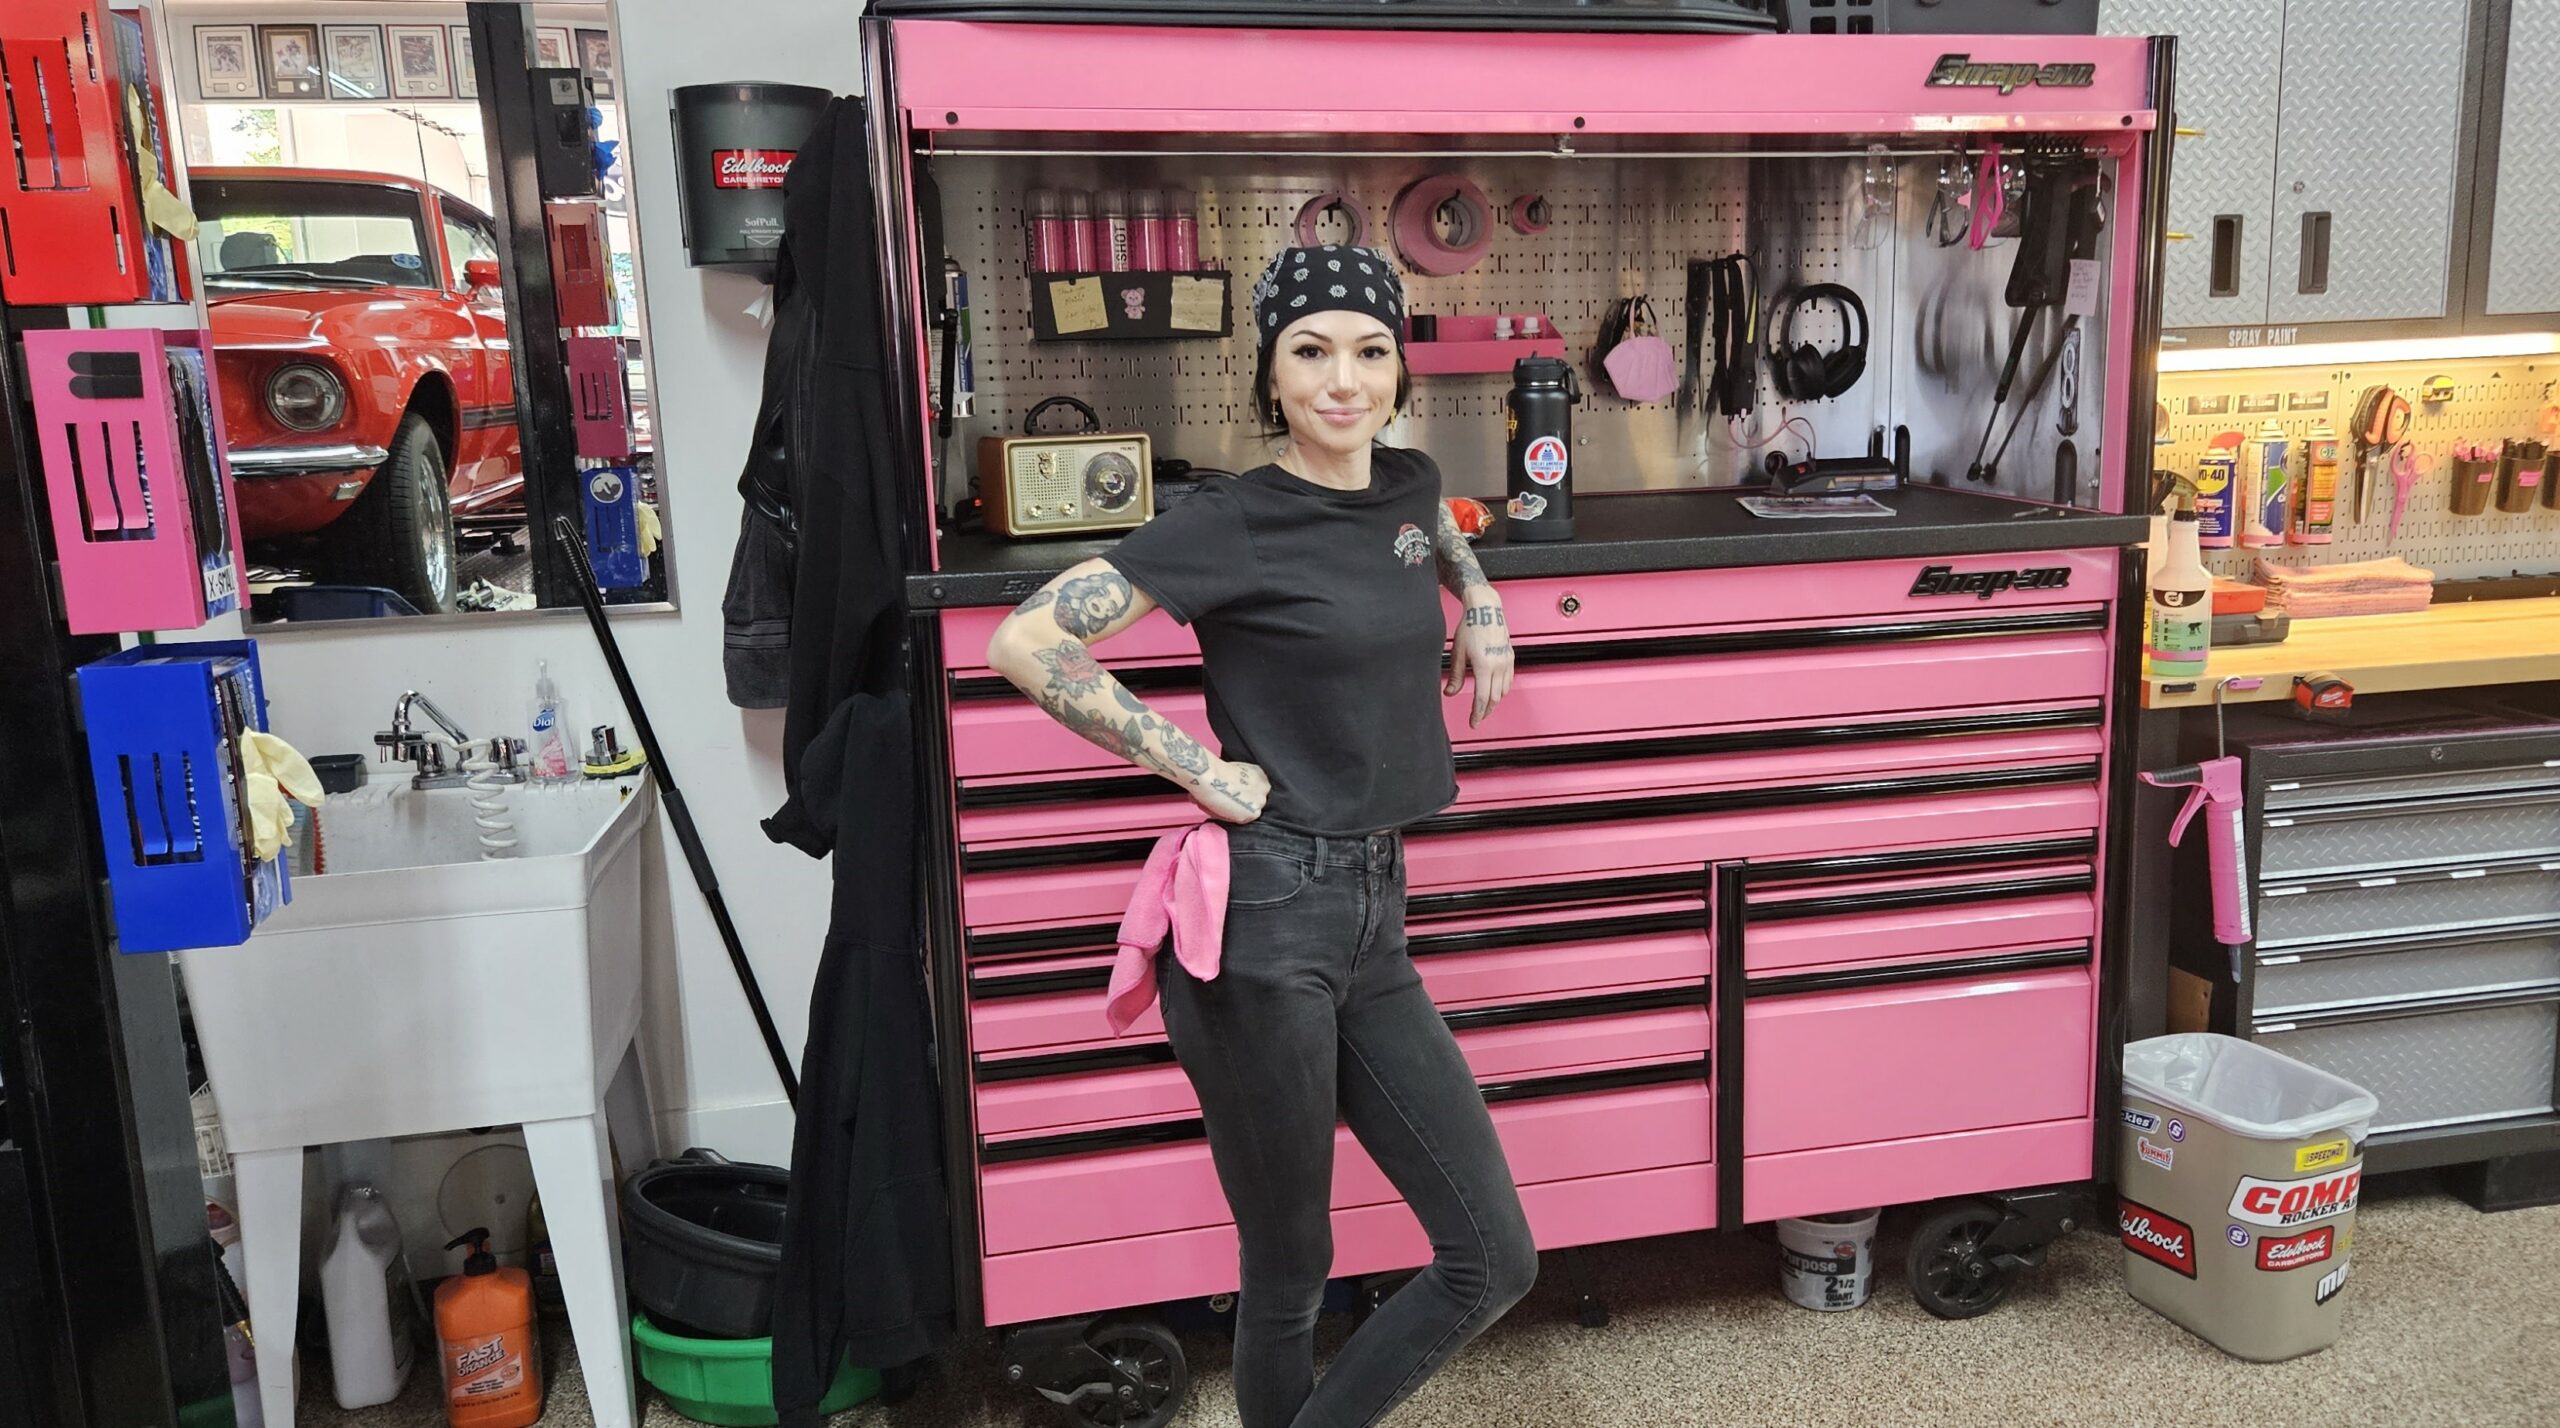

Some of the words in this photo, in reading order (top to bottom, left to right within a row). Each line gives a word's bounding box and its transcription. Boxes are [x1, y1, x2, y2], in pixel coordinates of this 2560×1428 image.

[721, 156, 792, 174] Edelbrock
[2228, 329, 2262, 347] SPRAY
[2267, 327, 2298, 346] PAINT
[1908, 565, 2072, 600] Snap-on
[533, 717, 555, 727] Dial
[2280, 1203, 2338, 1225] ROCKER
[2267, 1234, 2327, 1260] Edelbrock
[1825, 1276, 1838, 1293] 2
[1838, 1278, 1855, 1289] 1/2
[1826, 1291, 1854, 1302] QUART
[456, 1336, 503, 1367] FAST
[457, 1349, 505, 1377] ORANGE
